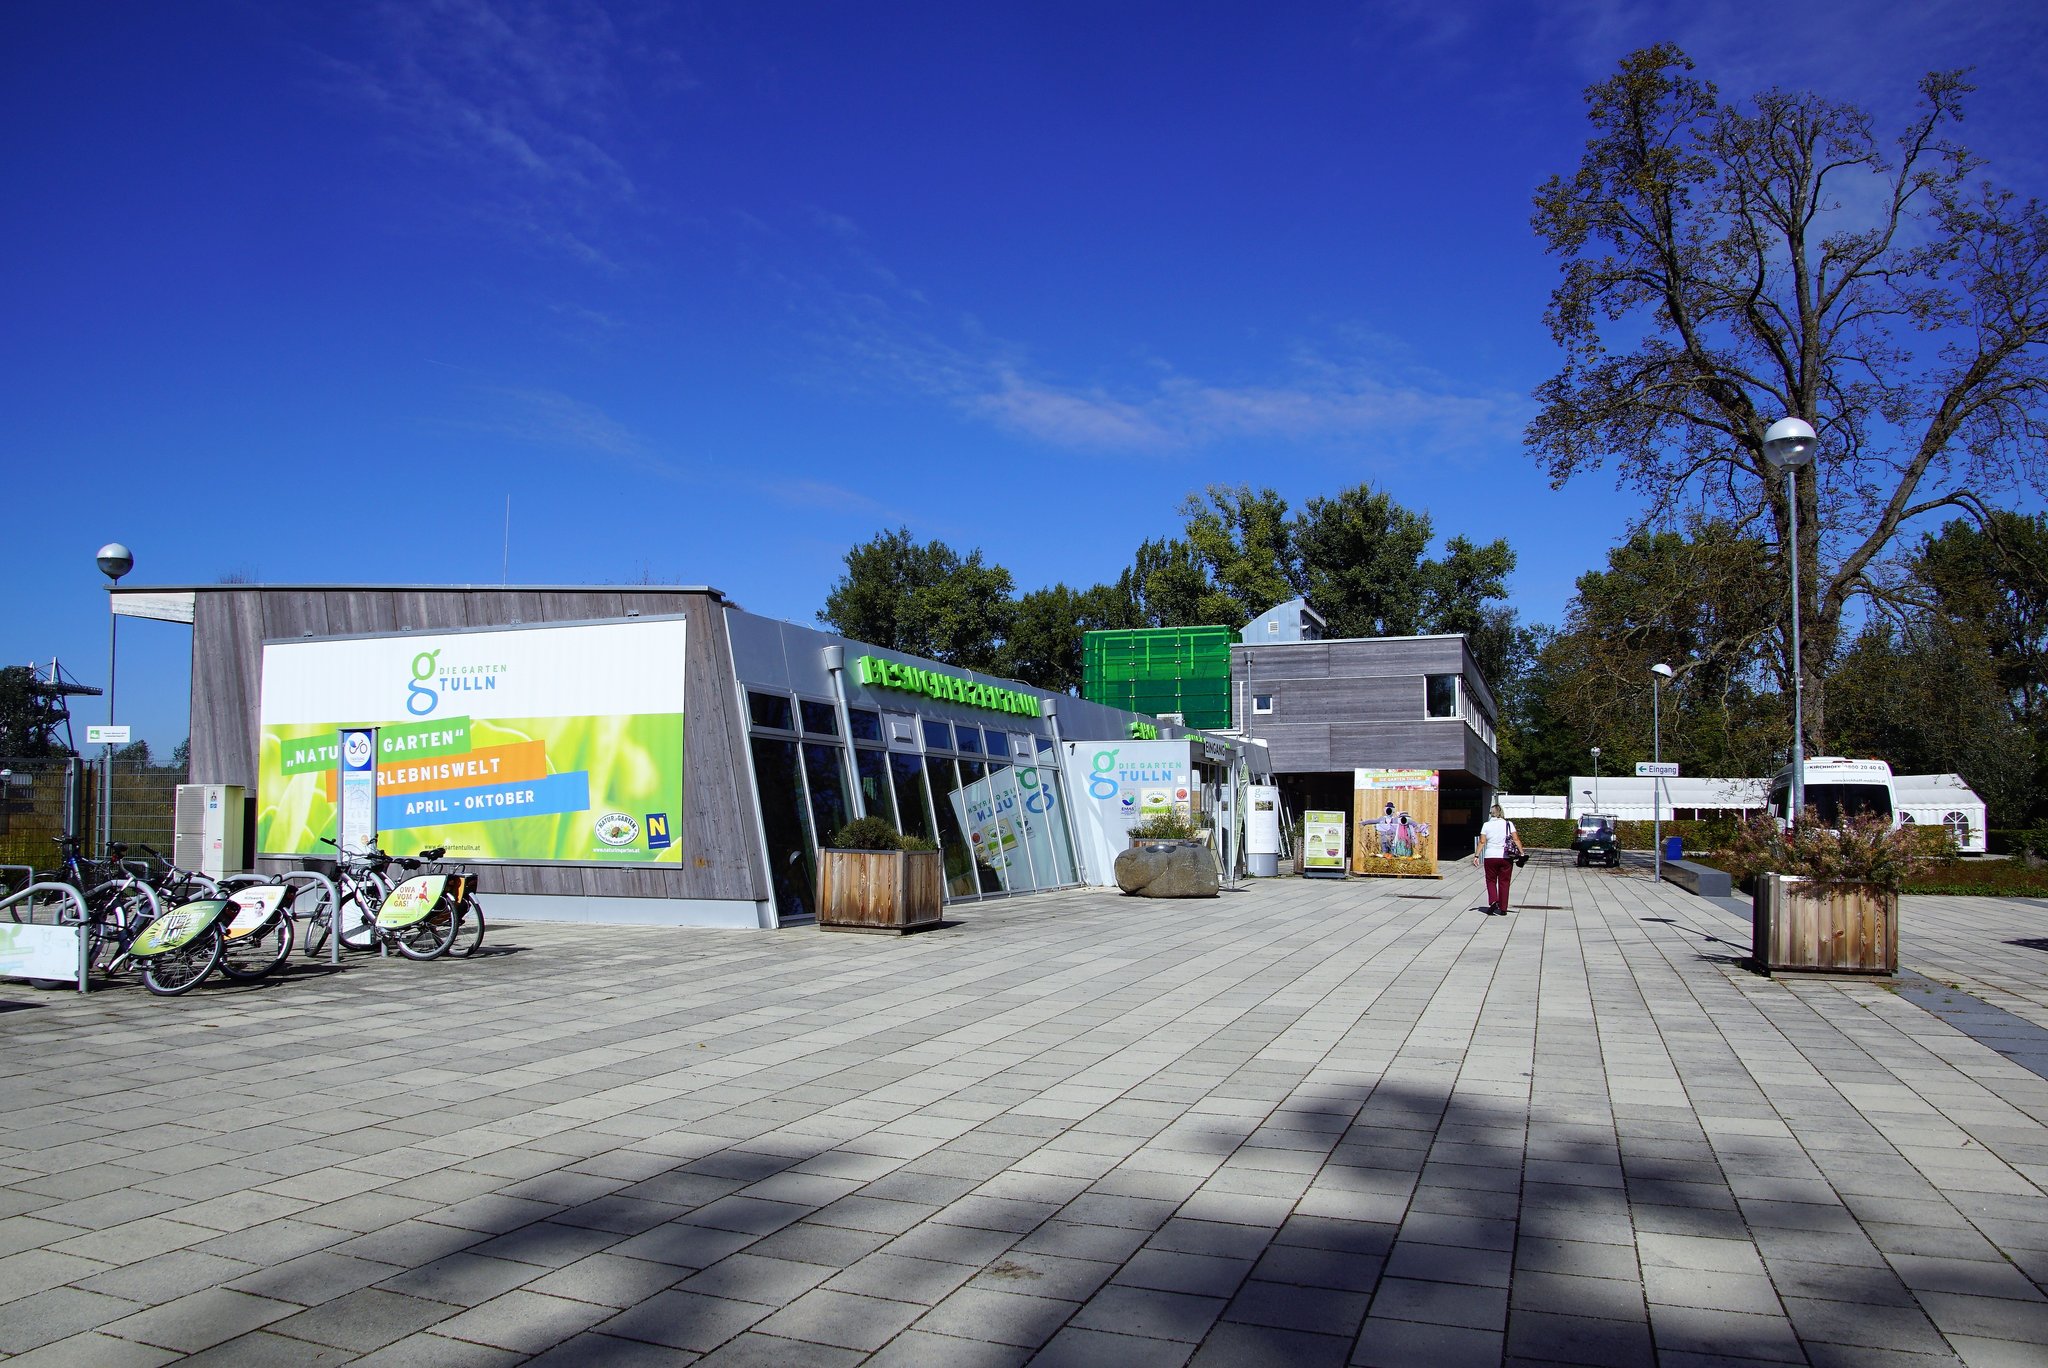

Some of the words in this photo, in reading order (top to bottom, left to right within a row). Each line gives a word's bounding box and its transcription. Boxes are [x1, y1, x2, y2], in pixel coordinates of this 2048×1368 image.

[440, 666, 457, 675] DIE
[461, 664, 507, 674] GARTEN
[440, 676, 496, 691] TULLN
[1205, 740, 1226, 757] EINGANG
[376, 757, 500, 786] RLEBNISWELT
[1140, 761, 1182, 769] GARTEN
[1649, 765, 1677, 775] Eingang
[1120, 770, 1172, 781] TULLN
[406, 800, 448, 815] APRIL
[465, 790, 534, 809] OKTOBER
